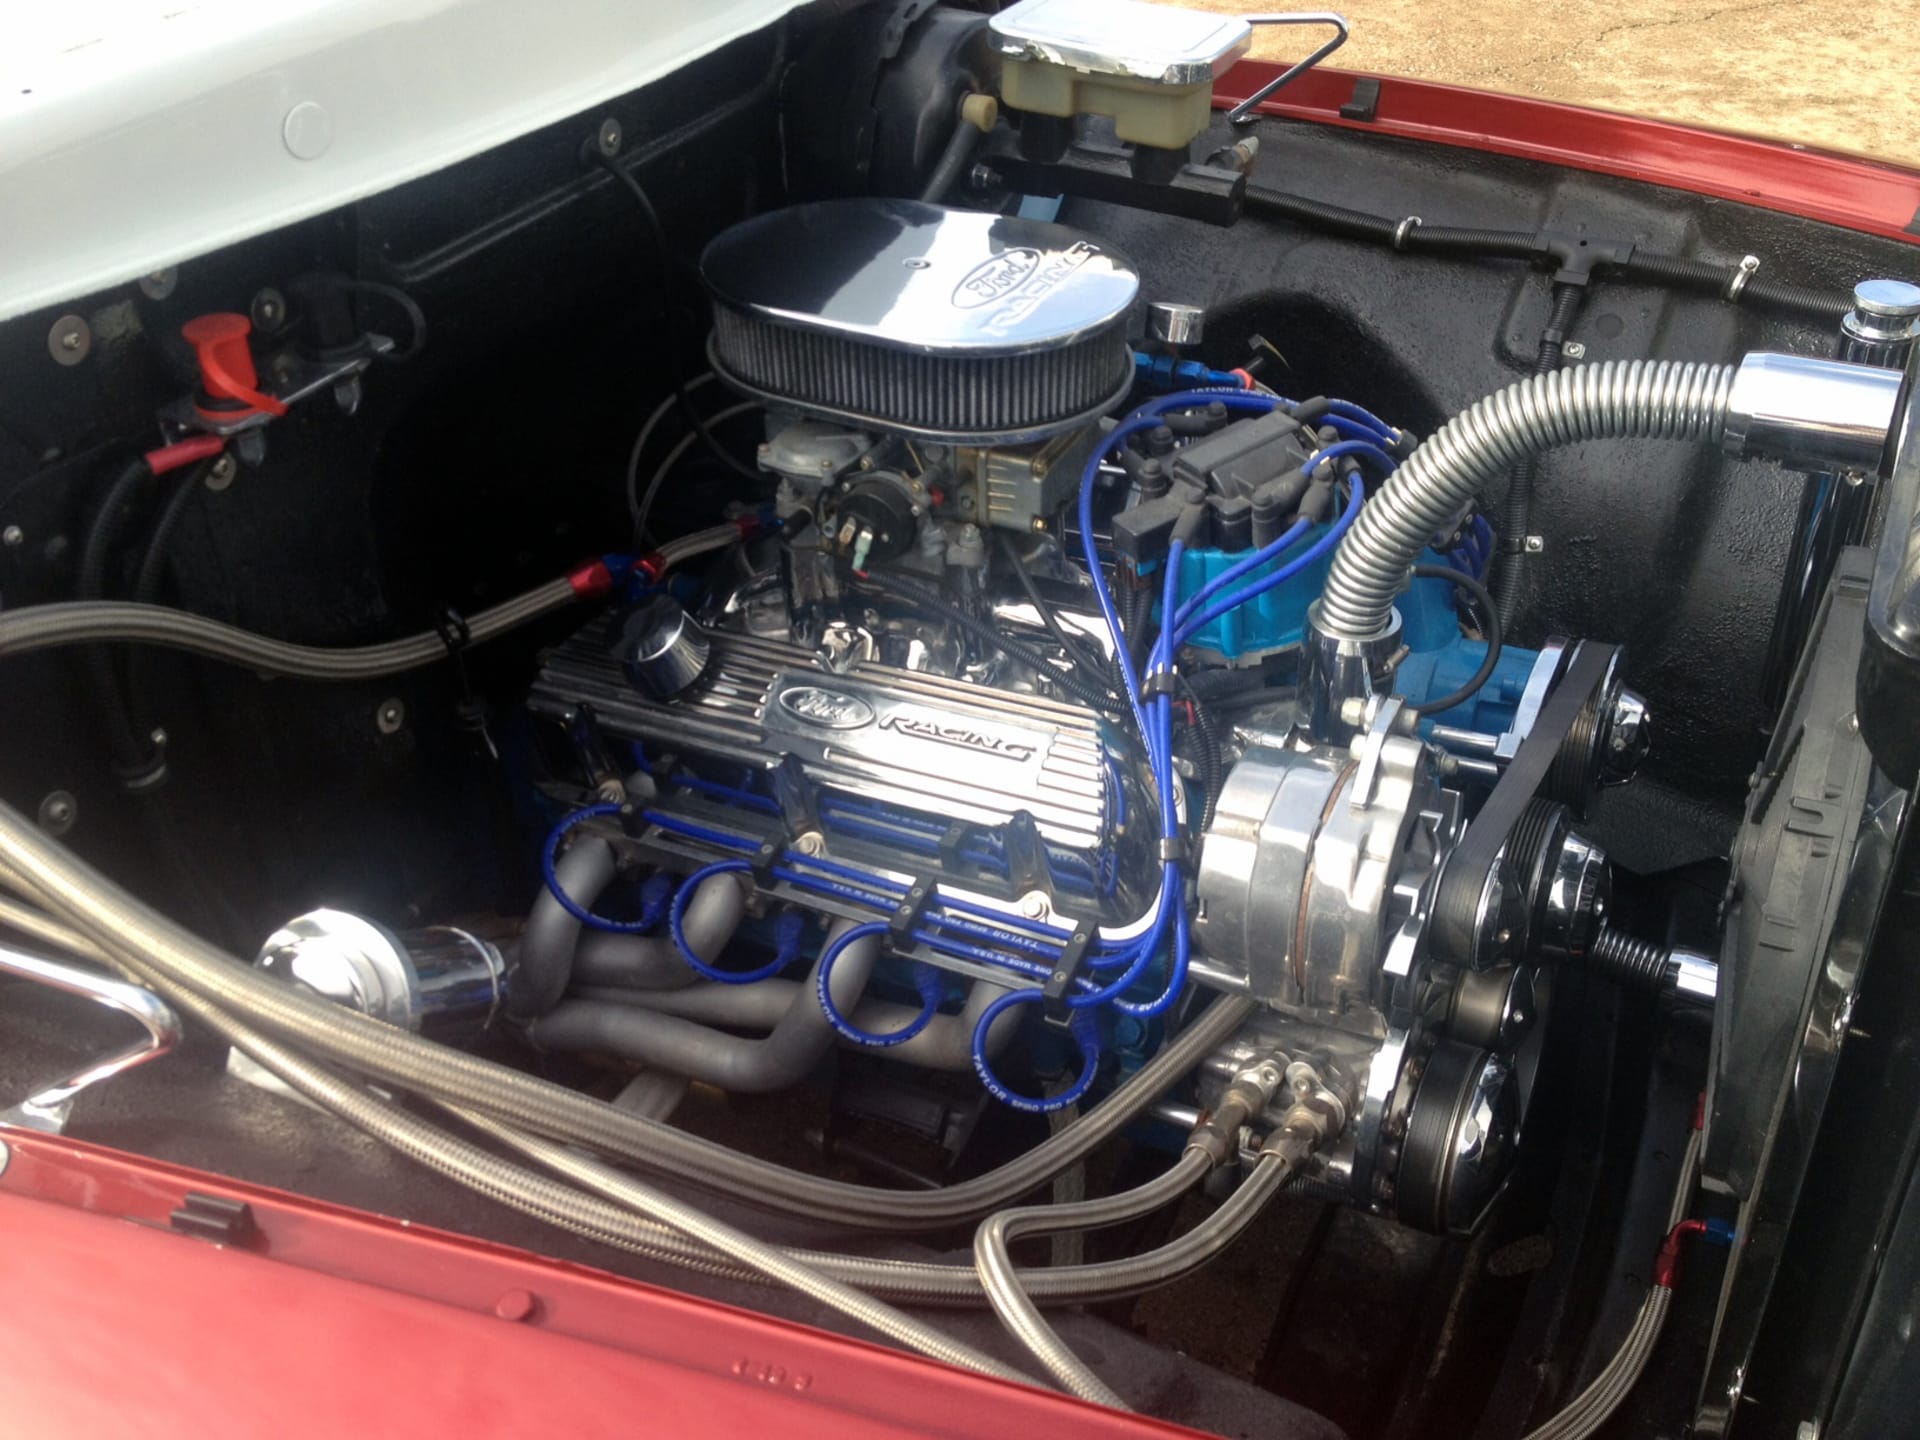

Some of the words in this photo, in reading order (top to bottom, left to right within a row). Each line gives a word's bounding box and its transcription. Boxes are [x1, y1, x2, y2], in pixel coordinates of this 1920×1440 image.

[964, 258, 1031, 299] Ford
[796, 687, 856, 722] Ford
[879, 713, 1038, 763] RACING
[992, 928, 1039, 949] TAYLOR
[1007, 957, 1032, 970] MADE
[816, 975, 836, 1024] TAYLOR
[972, 1052, 1008, 1102] TAYLOR
[1010, 1098, 1040, 1113] SPIRO
[1043, 1101, 1063, 1113] PRO
